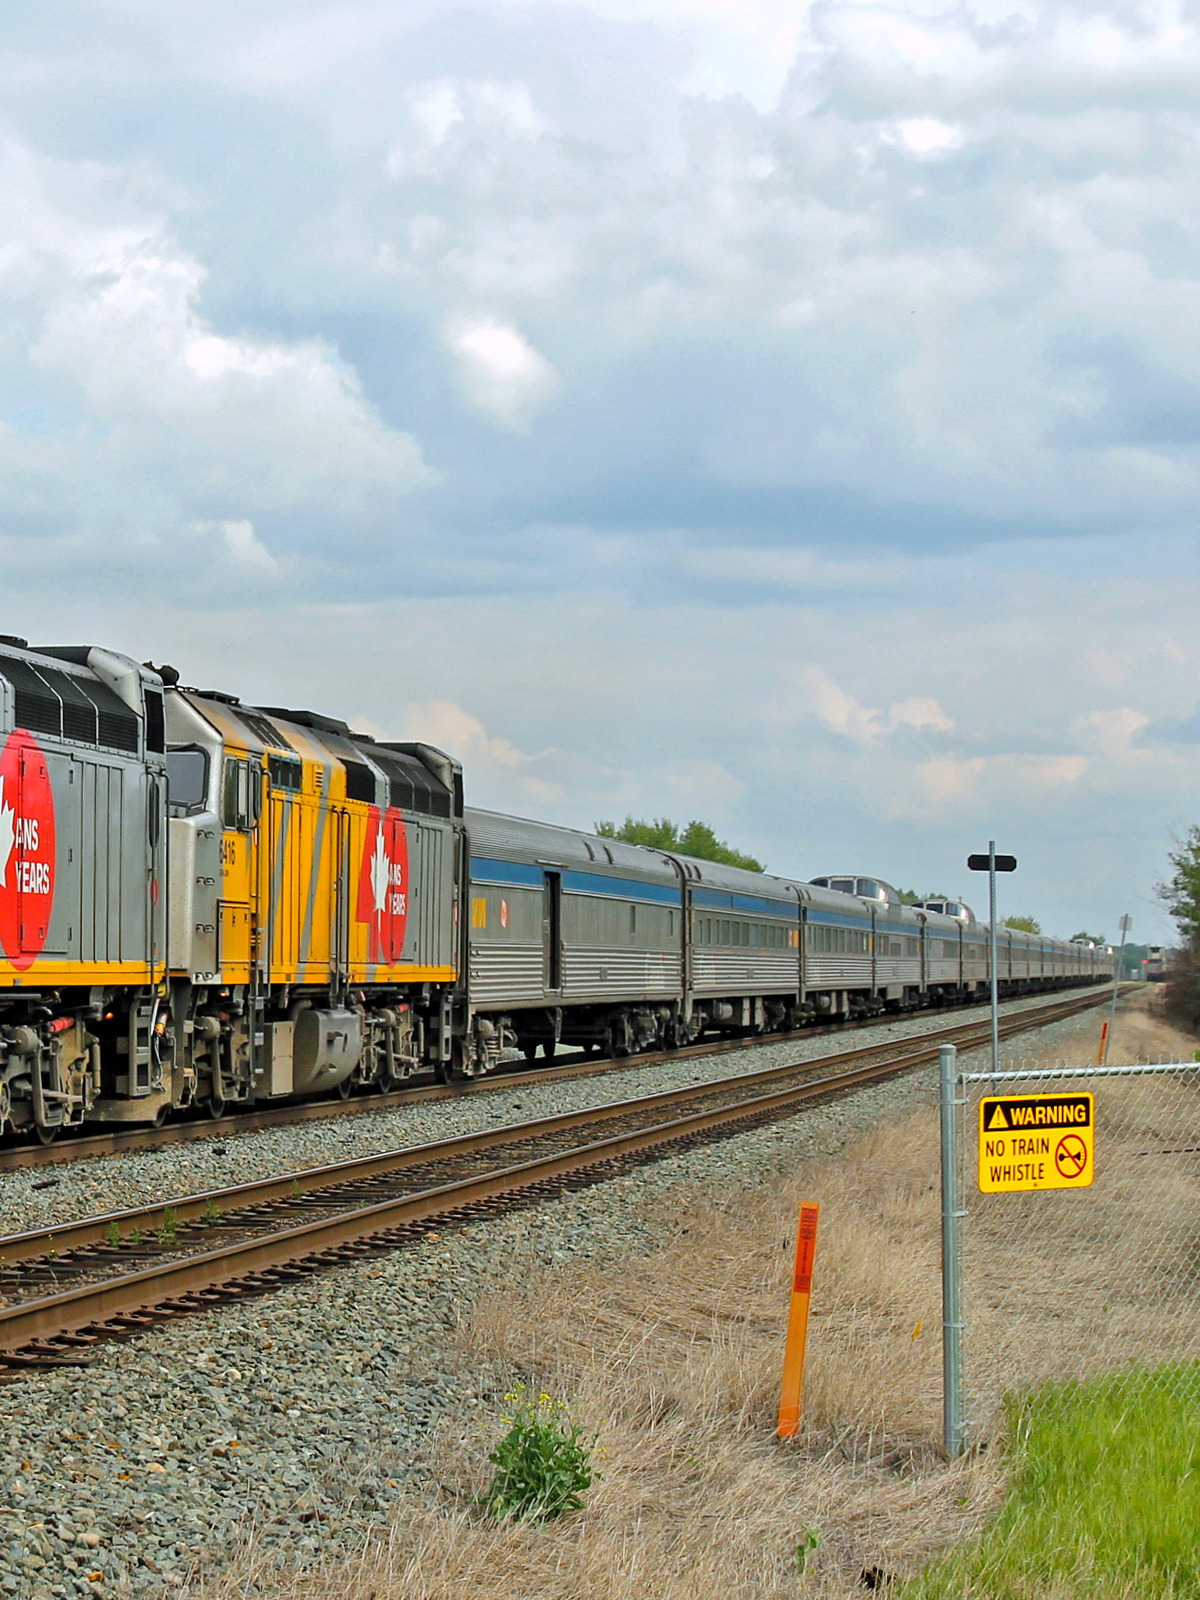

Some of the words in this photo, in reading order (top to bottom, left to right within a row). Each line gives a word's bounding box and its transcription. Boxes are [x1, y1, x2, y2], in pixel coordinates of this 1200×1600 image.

[15, 817, 39, 851] ANS
[219, 839, 235, 865] 6416
[15, 861, 50, 895] YEARS
[1010, 1103, 1087, 1126] WARNING
[986, 1139, 1006, 1158] NO
[1011, 1137, 1050, 1156] TRAIN
[990, 1163, 1045, 1183] WHISTLE
